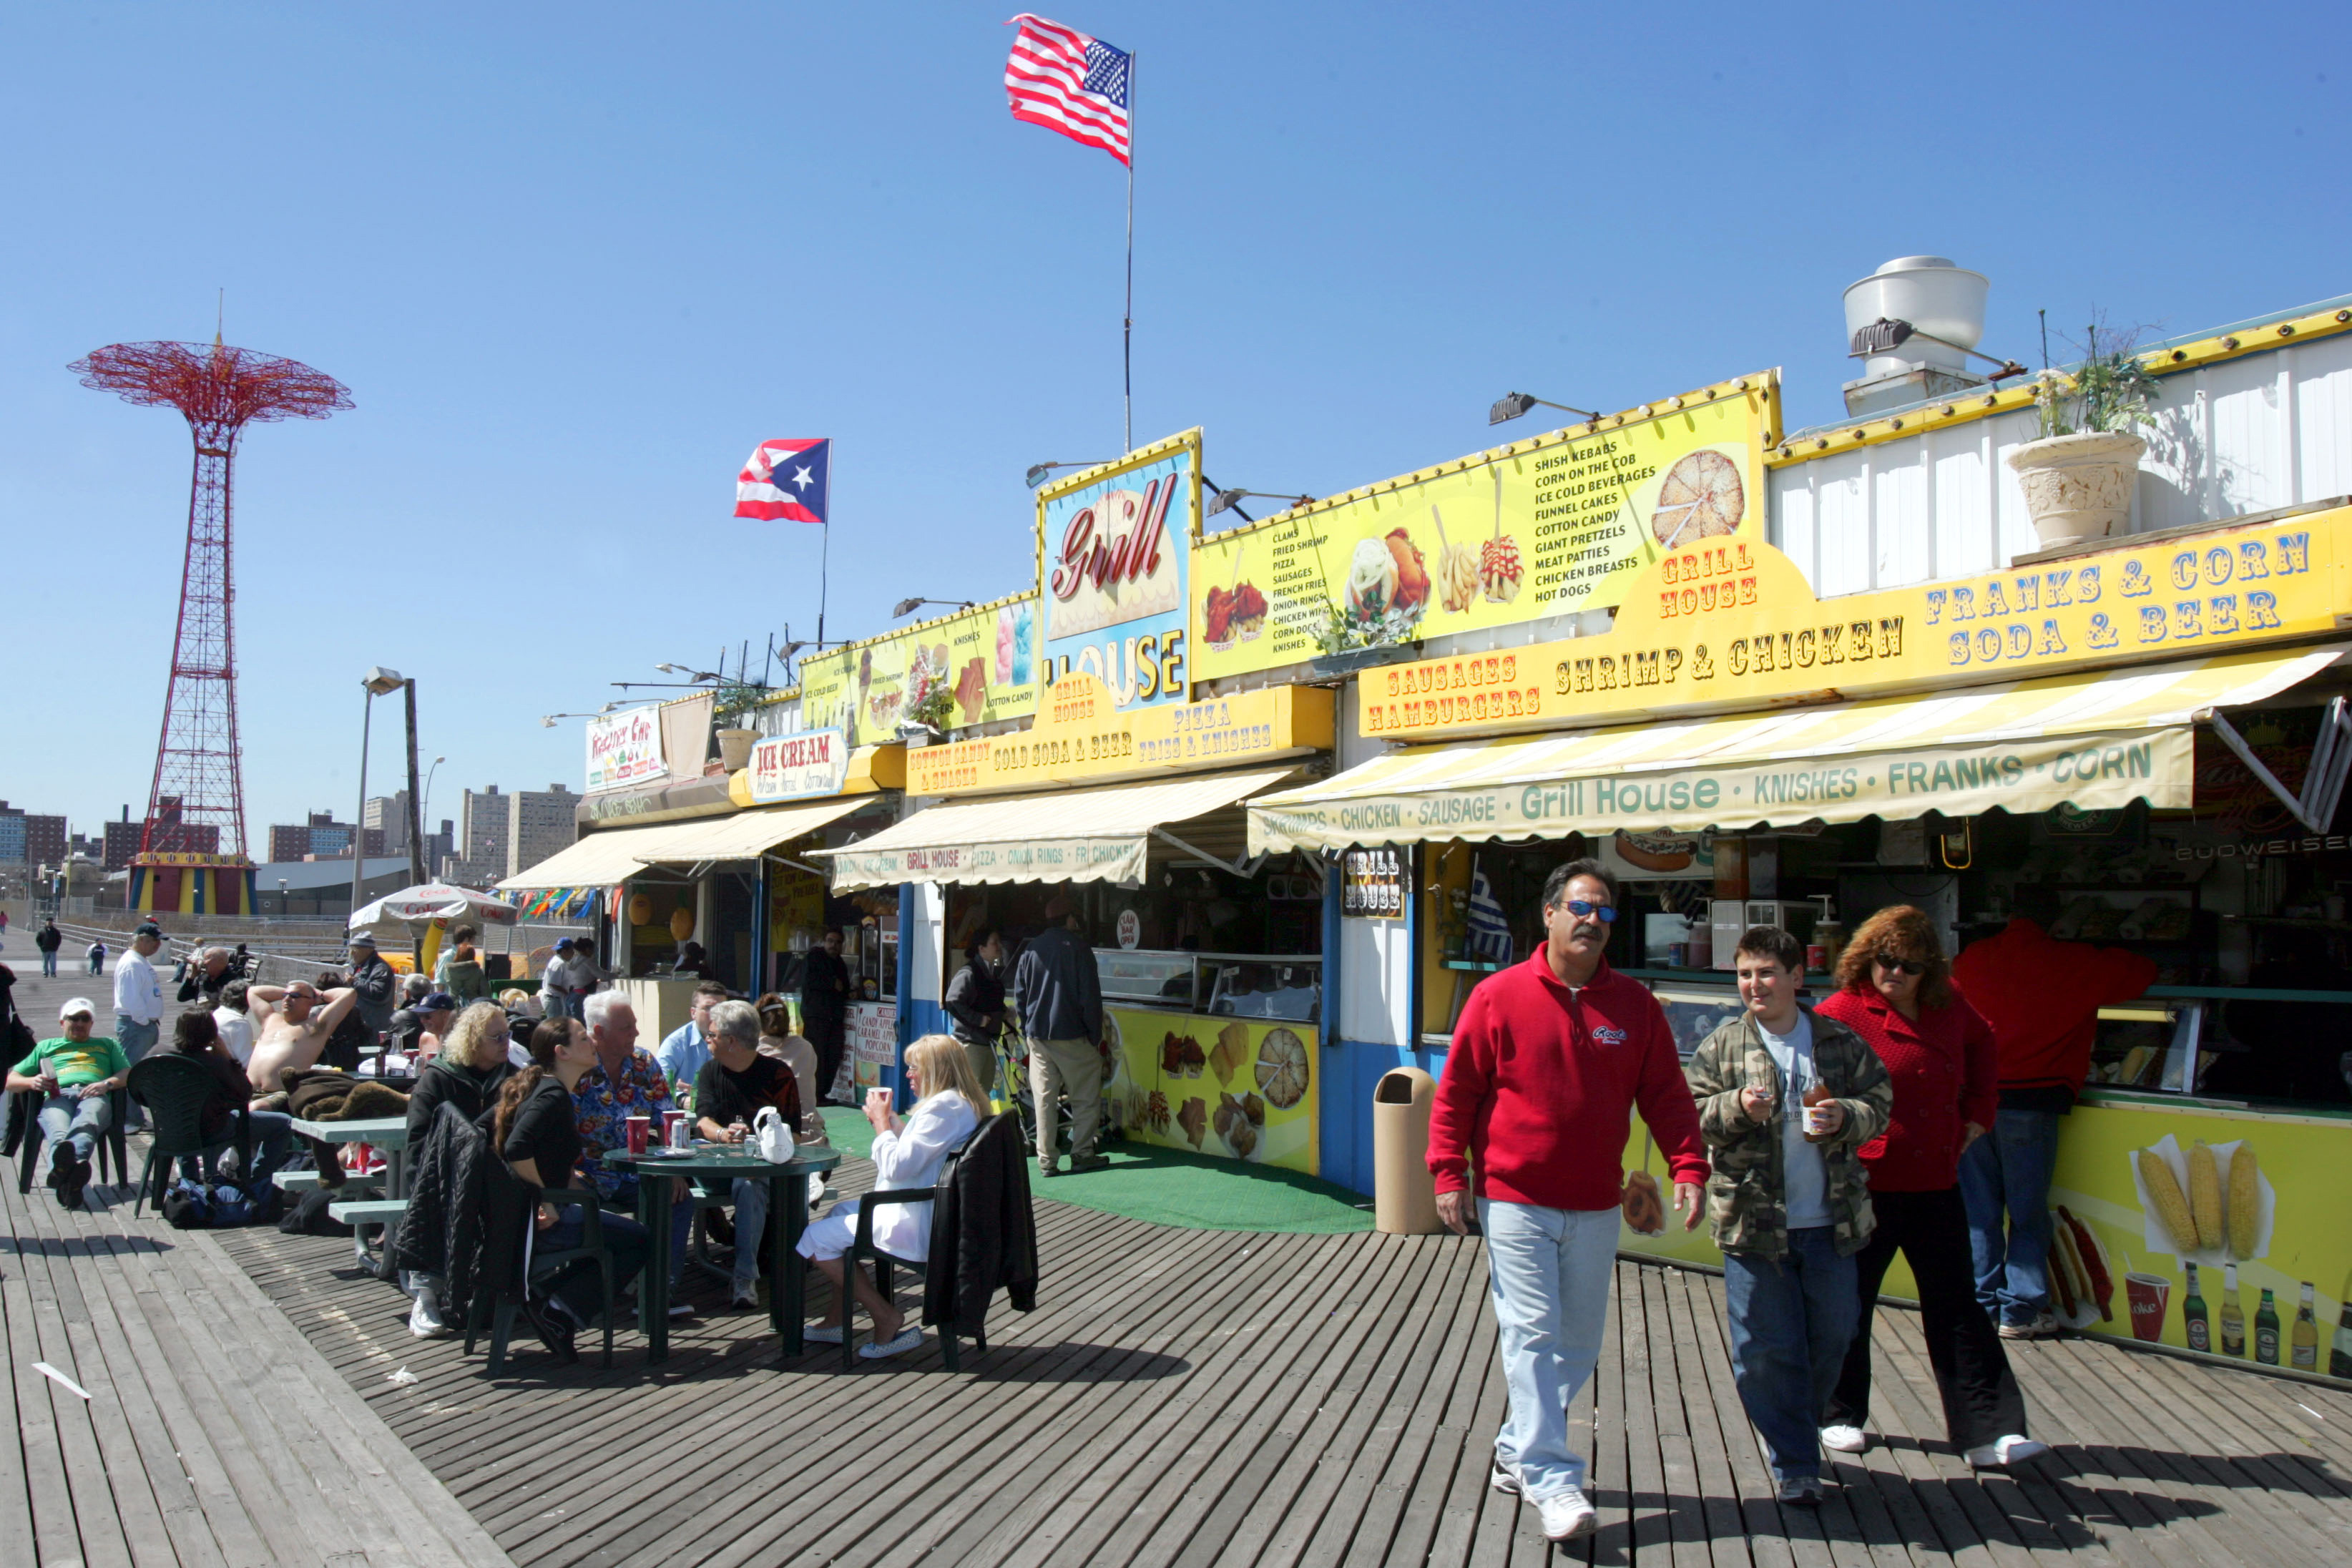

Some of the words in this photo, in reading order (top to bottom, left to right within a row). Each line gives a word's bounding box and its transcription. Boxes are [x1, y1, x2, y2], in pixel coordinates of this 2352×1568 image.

[1535, 455, 1568, 472] SHISH
[1572, 441, 1617, 462] KEBABS
[1535, 471, 1565, 488] CORN
[1569, 467, 1584, 480] ON
[1587, 461, 1609, 475] THE
[1612, 454, 1636, 469] COB
[1535, 492, 1553, 504] ICE
[1556, 484, 1585, 499] COLD
[1588, 466, 1656, 492] BEVERAGES
[1535, 503, 1578, 521] FUNNEL
[1582, 492, 1618, 511] CAKES
[1051, 472, 1178, 599] Grill
[1535, 519, 1578, 537] COTTON
[1582, 509, 1620, 527] CANDY
[1273, 529, 1299, 544] CLAMS
[1273, 544, 1295, 557] FRIED
[1297, 535, 1328, 551] SHRIMP
[1535, 538, 1567, 554] GIANT
[1570, 525, 1626, 547] PRETZELS
[1273, 558, 1295, 571] PIZZA
[1535, 555, 1564, 570] MEAT
[1567, 545, 1610, 564] PATTIES
[1661, 542, 1755, 586] GRILL
[1273, 567, 1313, 584] SAUSAGES
[1535, 567, 1584, 587] CHICKEN
[1587, 557, 1638, 577] BREASTS
[1924, 564, 2102, 624] FRANKS
[2118, 559, 2152, 598] &
[2170, 531, 2310, 590] CORN
[1273, 583, 1303, 598] FRENCH
[1305, 577, 1327, 590] FRIES
[1535, 589, 1557, 603] HOT
[1560, 583, 1592, 598] DOGS
[1658, 577, 1758, 619] HOUSE
[1273, 598, 1298, 612] ONION
[1300, 592, 1324, 606] RINGS
[1273, 611, 1307, 625] CHICKEN
[1948, 617, 2067, 665] SODA
[2084, 612, 2120, 650] &
[2137, 589, 2282, 643] BEER
[954, 631, 981, 647] KNISHES
[1273, 626, 1294, 640] CORN
[1273, 639, 1305, 653] KNISHES
[1554, 644, 1683, 696] SHRIMP
[1690, 642, 1715, 680] &
[1728, 614, 1905, 676] CHICKEN
[872, 676, 886, 685] FRIED
[1054, 677, 1094, 701] GRILL
[1386, 655, 1518, 697] SAUSAGES
[813, 687, 826, 697] COLD
[826, 683, 838, 694] BEER
[986, 697, 1010, 708] COTTON
[1011, 691, 1033, 703] CANDY
[1054, 700, 1094, 724] HOUSE
[1173, 702, 1231, 733] PIZZA
[1368, 686, 1540, 732] HAMBURGERS
[757, 745, 777, 774] ICE
[780, 734, 830, 770] CREAM
[910, 748, 951, 770] COTTON
[954, 742, 991, 765] CANDY
[994, 746, 1028, 771] COLD
[1032, 738, 1070, 767] SODA
[1090, 732, 1133, 760] BEER
[1139, 737, 1181, 763] FRIES
[1202, 724, 1271, 755] KNISHES
[932, 767, 977, 790] SNACKS
[1263, 810, 1328, 837] SHRIMPS
[1341, 803, 1401, 832] CHICKEN
[1417, 796, 1496, 825] SAUSAGE
[1520, 778, 1583, 820] Grill
[1595, 778, 1721, 815] House
[1754, 768, 1858, 804] KNISHES
[1888, 753, 2024, 794] FRANKS
[2052, 742, 2152, 783] CORN
[876, 858, 898, 871] CREAM
[907, 850, 928, 871] GRILL
[931, 849, 959, 868] HOUSE
[973, 851, 996, 866] PIZZA
[1007, 849, 1033, 865] ONION
[1037, 848, 1063, 864] RINGS
[1093, 844, 1135, 862] CHICKEN
[2175, 835, 2352, 861] BUDWEISE
[1346, 850, 1400, 876] GRILL
[1345, 883, 1401, 909] HOUSE
[480, 905, 505, 920] Coke
[1120, 935, 1135, 945] OPEN
[1121, 926, 1134, 935] BAR
[861, 1016, 878, 1028] CANDY
[1593, 1026, 1627, 1040] Roots
[865, 1039, 891, 1052] POPCORN
